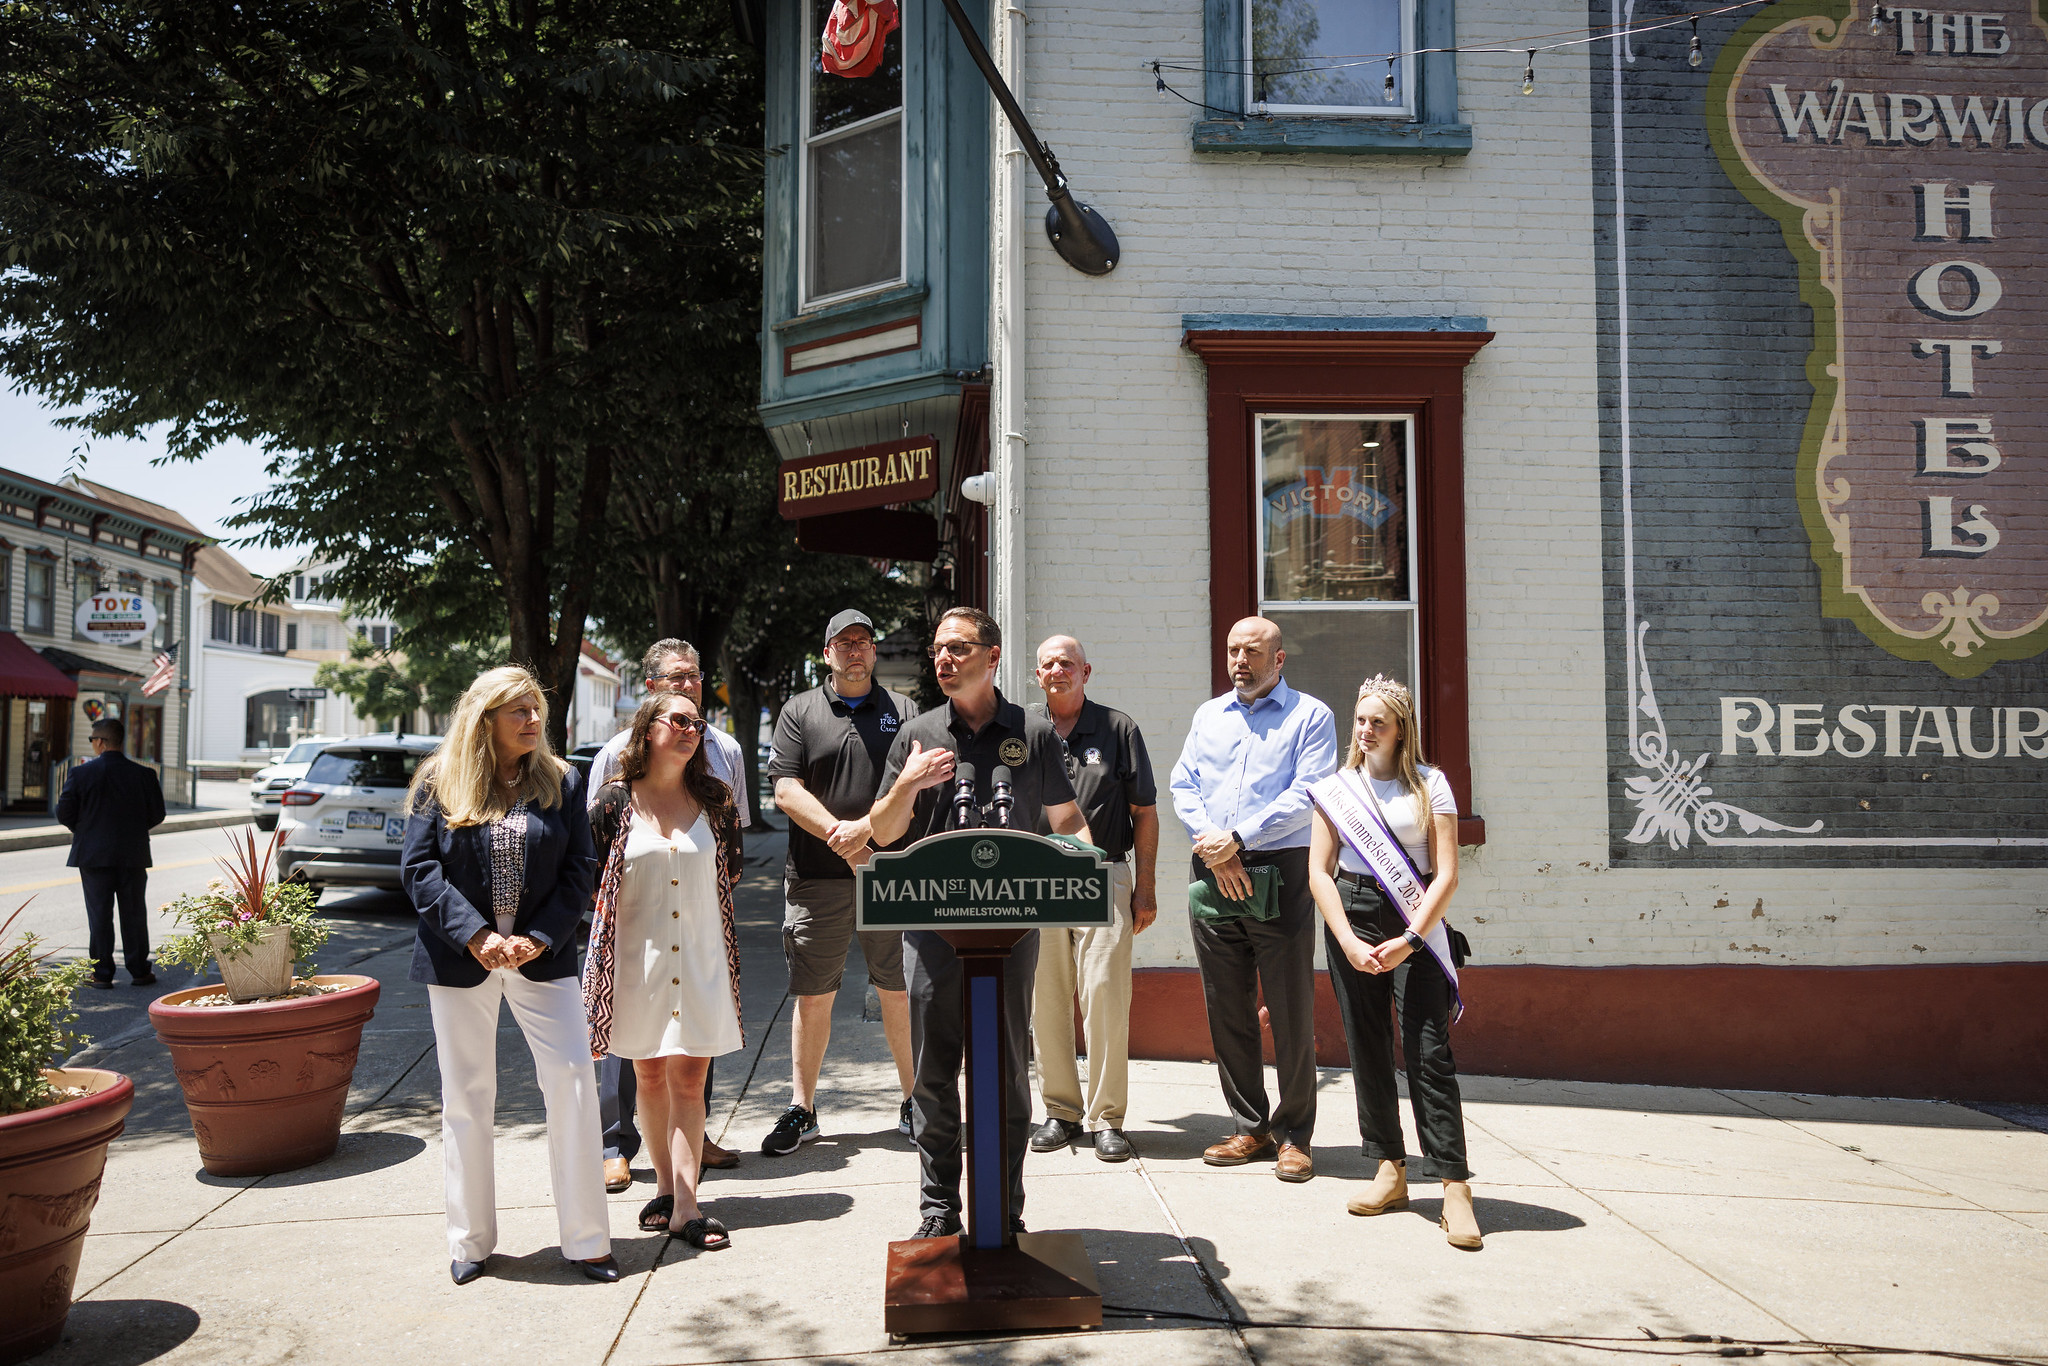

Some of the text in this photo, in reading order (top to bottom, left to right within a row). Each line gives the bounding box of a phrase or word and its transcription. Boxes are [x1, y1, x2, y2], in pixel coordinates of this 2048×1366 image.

[1887, 8, 2011, 55] THE
[1769, 79, 2048, 148] WARWIC
[784, 447, 932, 502] RESTAURANT
[1272, 485, 1388, 516] VICTORY
[92, 598, 142, 611] TOYS
[1719, 697, 2048, 759] RESTAUR
[1325, 783, 1422, 911] Miss Hummelstown 2024
[872, 877, 1101, 901] MAIN ST. MATTERS
[934, 907, 1038, 917] HUMMELSTOWN, PA
